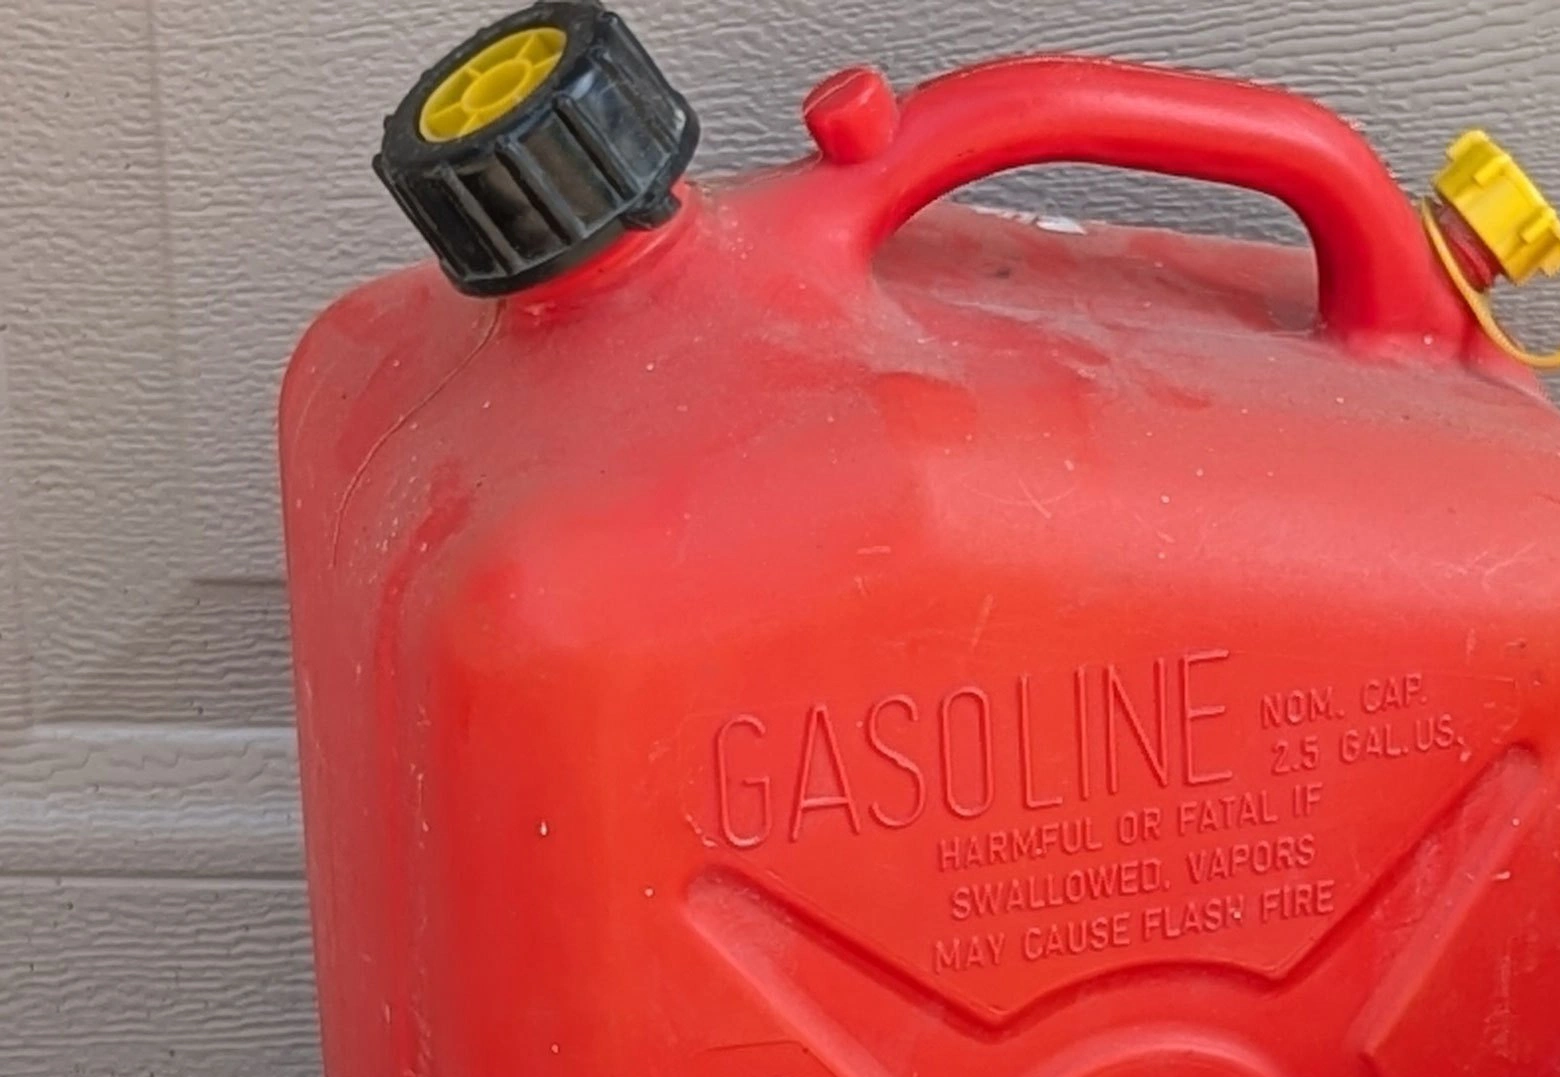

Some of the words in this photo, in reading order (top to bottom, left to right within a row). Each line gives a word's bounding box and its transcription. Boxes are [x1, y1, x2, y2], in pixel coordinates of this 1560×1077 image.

[1260, 684, 1344, 729] NOM.
[1361, 673, 1429, 714] CAP.
[712, 647, 1233, 848] GASOLINE
[1270, 733, 1321, 777] 2.5
[938, 817, 1103, 872] HARMFUL
[1117, 808, 1163, 846] OR
[1176, 790, 1279, 835] FATAL
[1292, 781, 1323, 818] IF
[1185, 834, 1317, 884] VAPORS
[934, 934, 1006, 974] MAY
[1021, 912, 1131, 962] CAUSE
[1142, 896, 1245, 939] FLASH
[1260, 879, 1336, 922] FIRE
